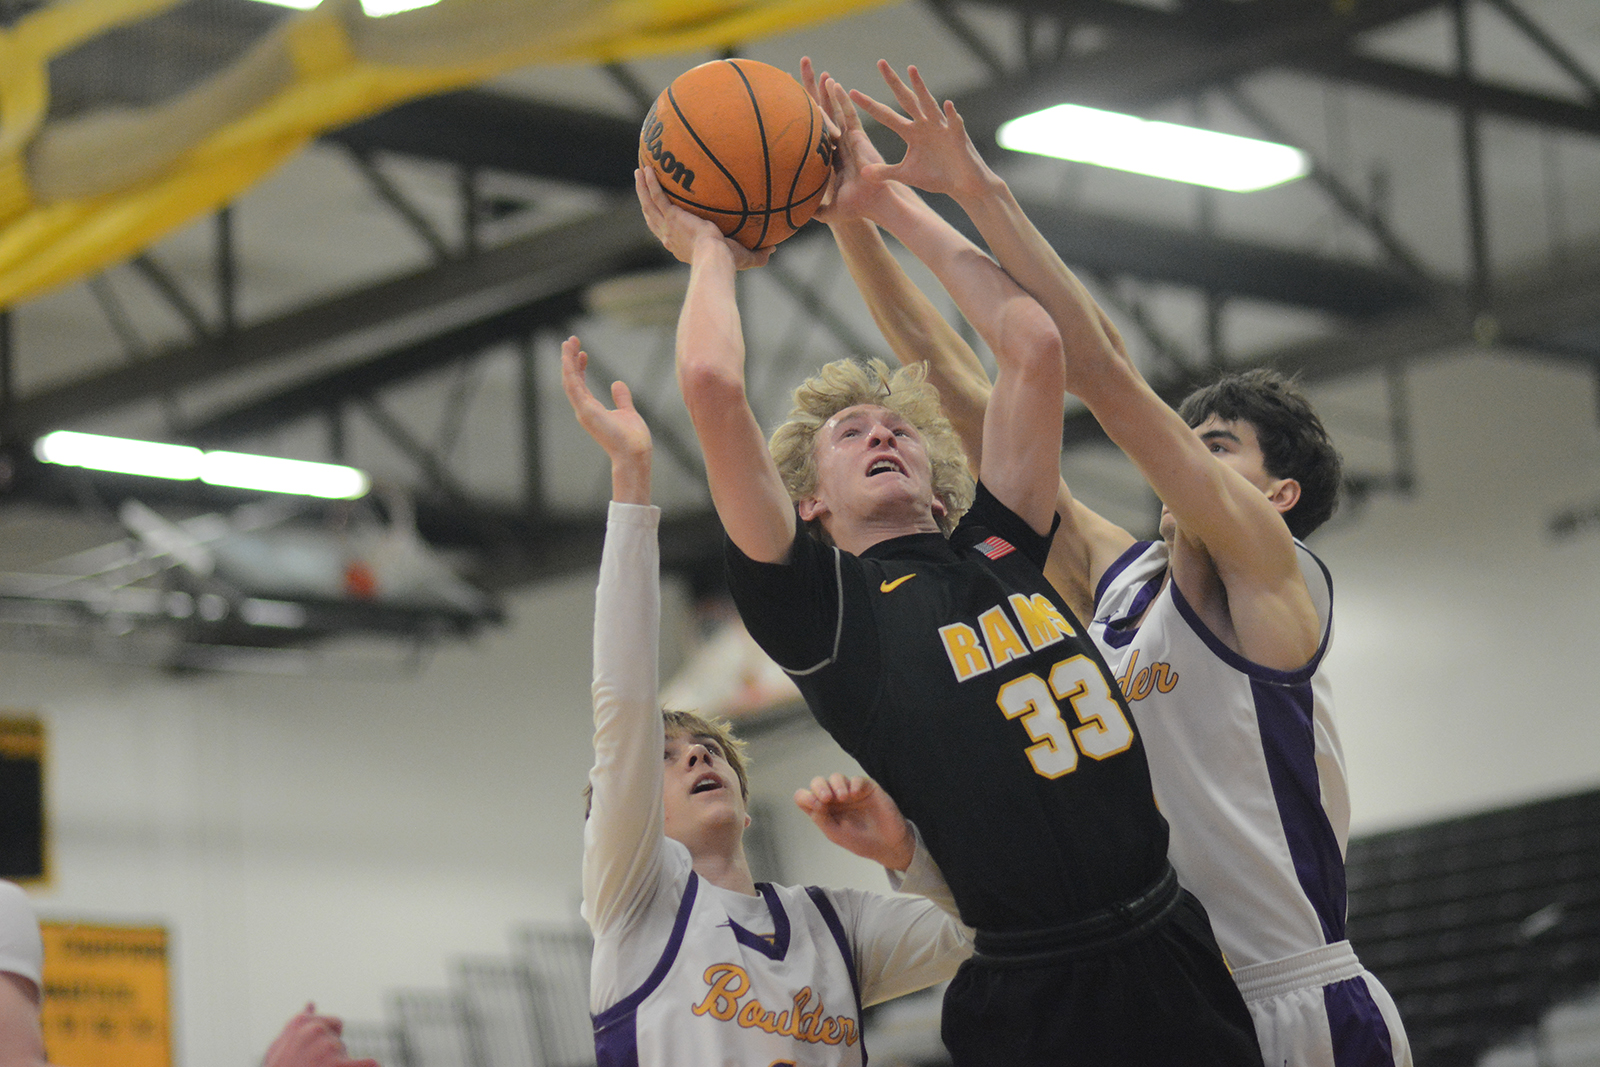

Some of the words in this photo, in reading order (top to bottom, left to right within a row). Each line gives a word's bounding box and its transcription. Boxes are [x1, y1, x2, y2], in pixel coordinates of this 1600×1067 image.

[938, 592, 1078, 683] RAMS
[1115, 648, 1179, 704] der
[996, 653, 1134, 780] 33
[691, 962, 858, 1047] Boulder
